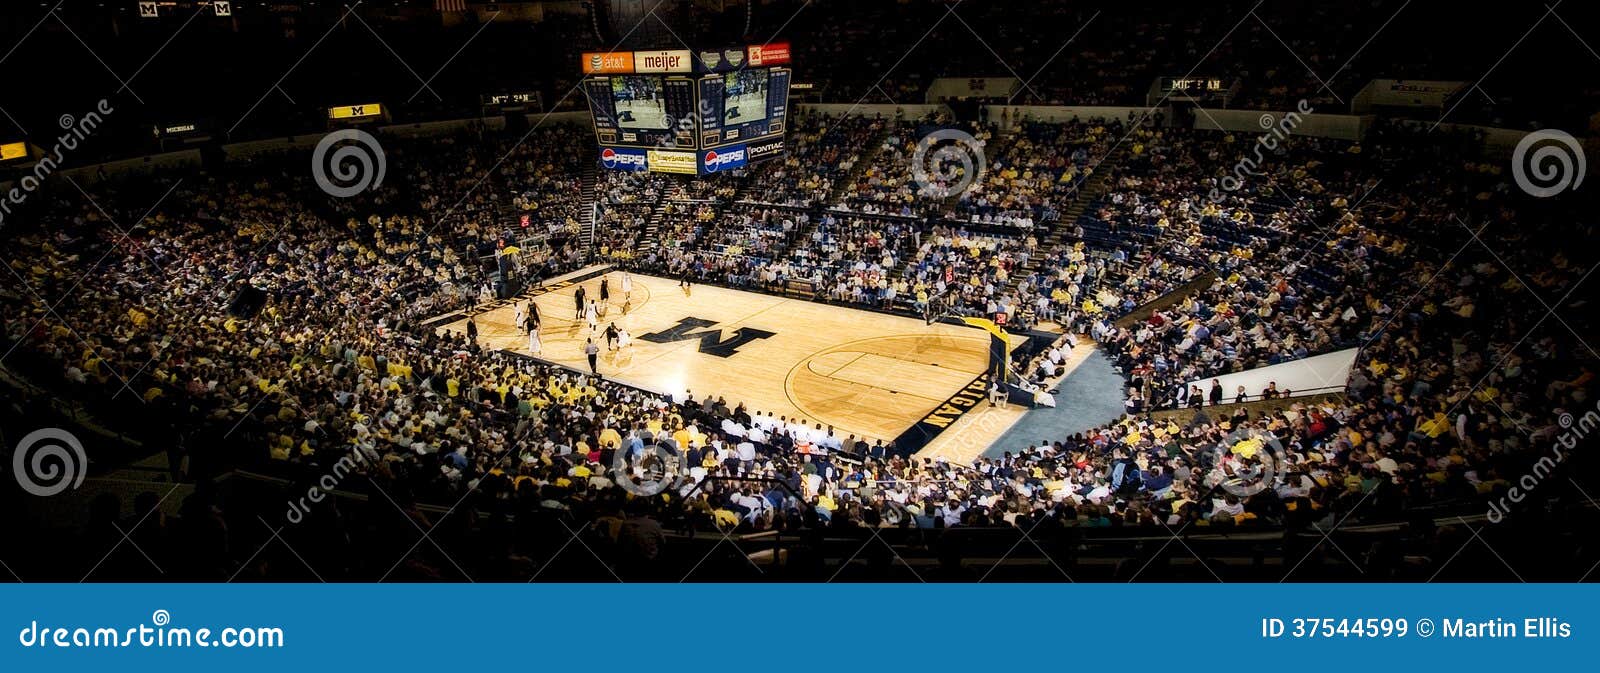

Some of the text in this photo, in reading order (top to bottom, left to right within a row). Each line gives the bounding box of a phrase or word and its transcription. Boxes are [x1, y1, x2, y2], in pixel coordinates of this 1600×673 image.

[141, 4, 156, 14] M
[216, 4, 230, 13] M
[605, 55, 624, 69] at&t
[644, 51, 680, 71] meijer
[352, 106, 363, 115] M
[750, 141, 784, 154] PONTIAC
[614, 153, 645, 165] PEPSI
[717, 150, 744, 164] PEPSI
[636, 316, 778, 358] M
[922, 373, 989, 429] HIGAN
